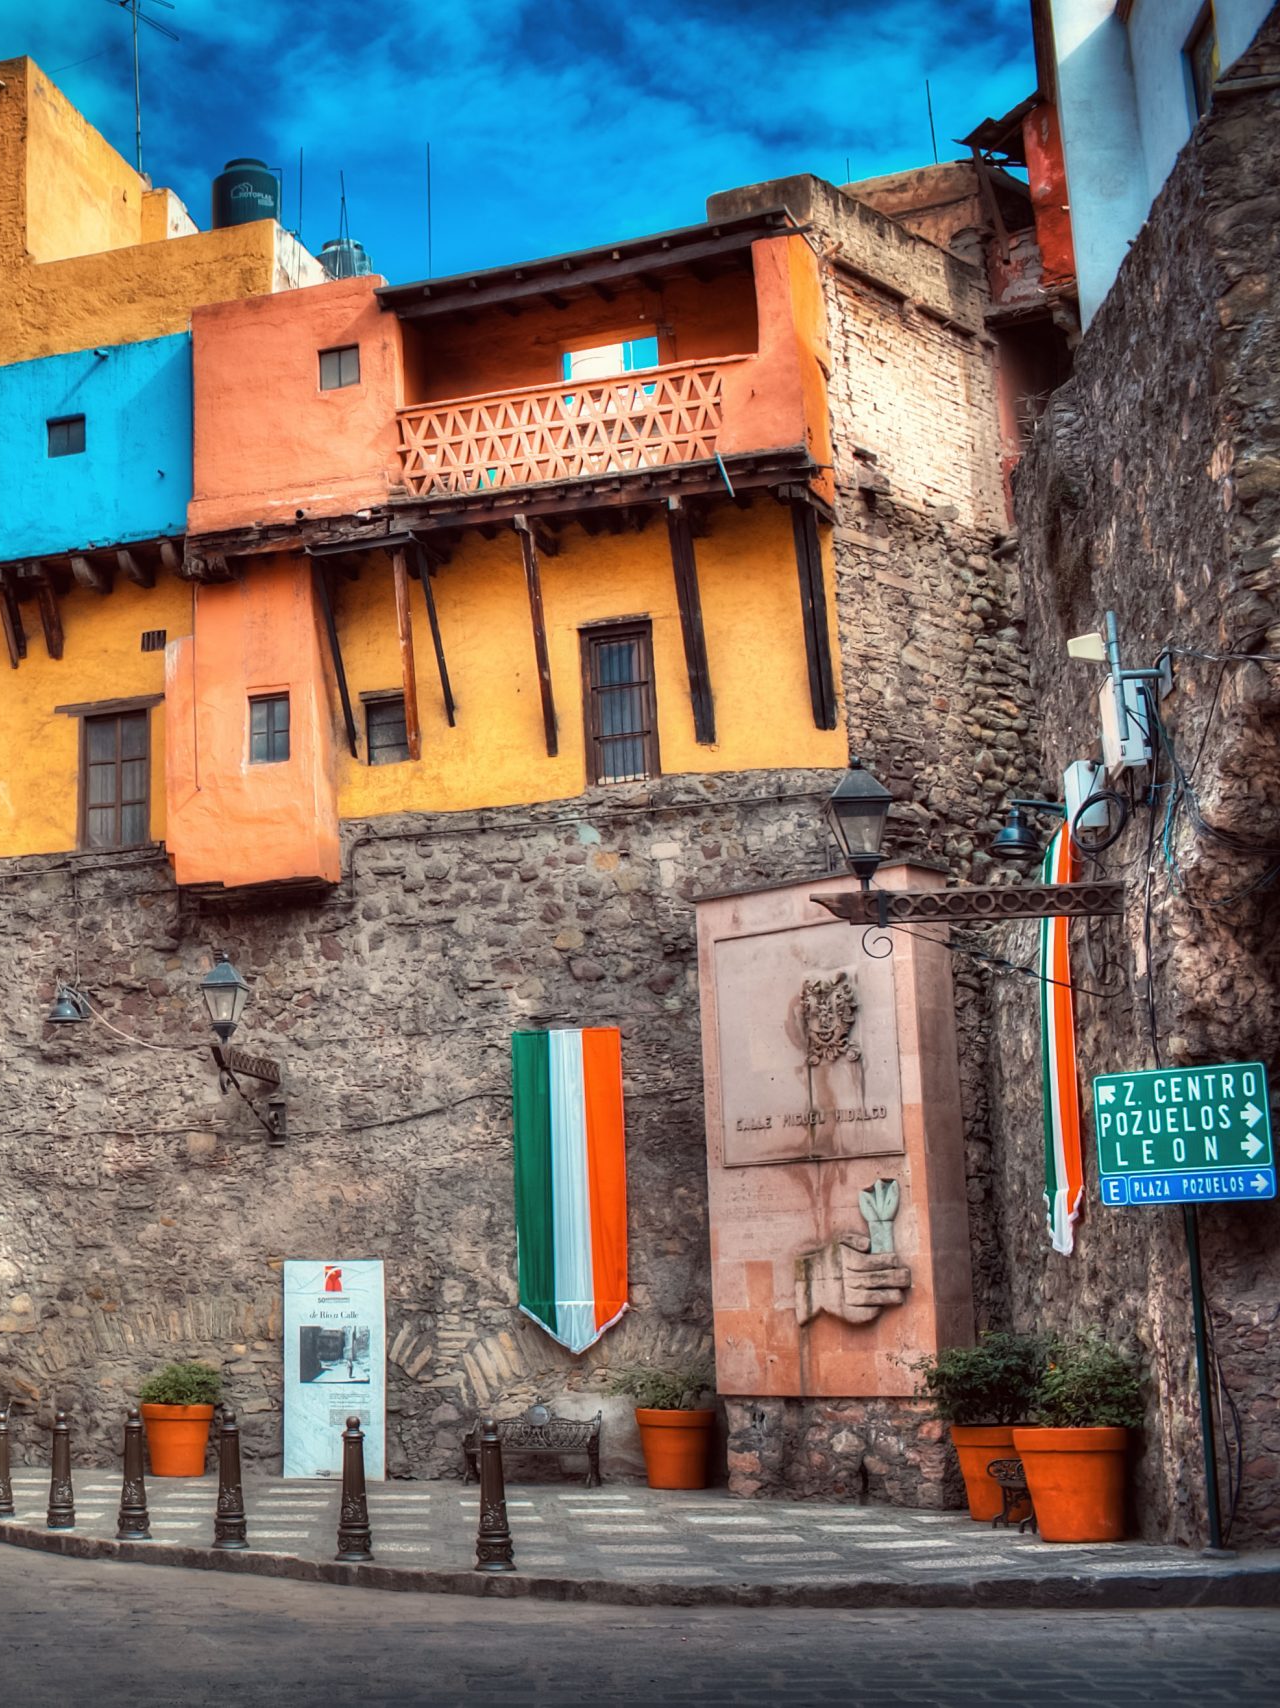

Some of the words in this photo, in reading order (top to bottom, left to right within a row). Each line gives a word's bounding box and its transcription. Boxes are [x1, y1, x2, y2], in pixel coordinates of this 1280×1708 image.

[1122, 1081, 1142, 1106] Z.
[1153, 1071, 1256, 1104] CENTRO
[736, 1117, 773, 1132] CALLE
[783, 1109, 826, 1128] MIGUEL
[835, 1105, 888, 1123] HIDALGO
[1100, 1104, 1232, 1138] POZUELOS
[1115, 1135, 1219, 1166] LEON
[1109, 1181, 1120, 1201] E
[1133, 1180, 1170, 1198] PLAZA
[1182, 1176, 1245, 1195] POZUELOS
[309, 1310, 318, 1319] de
[340, 1310, 359, 1319] Calle
